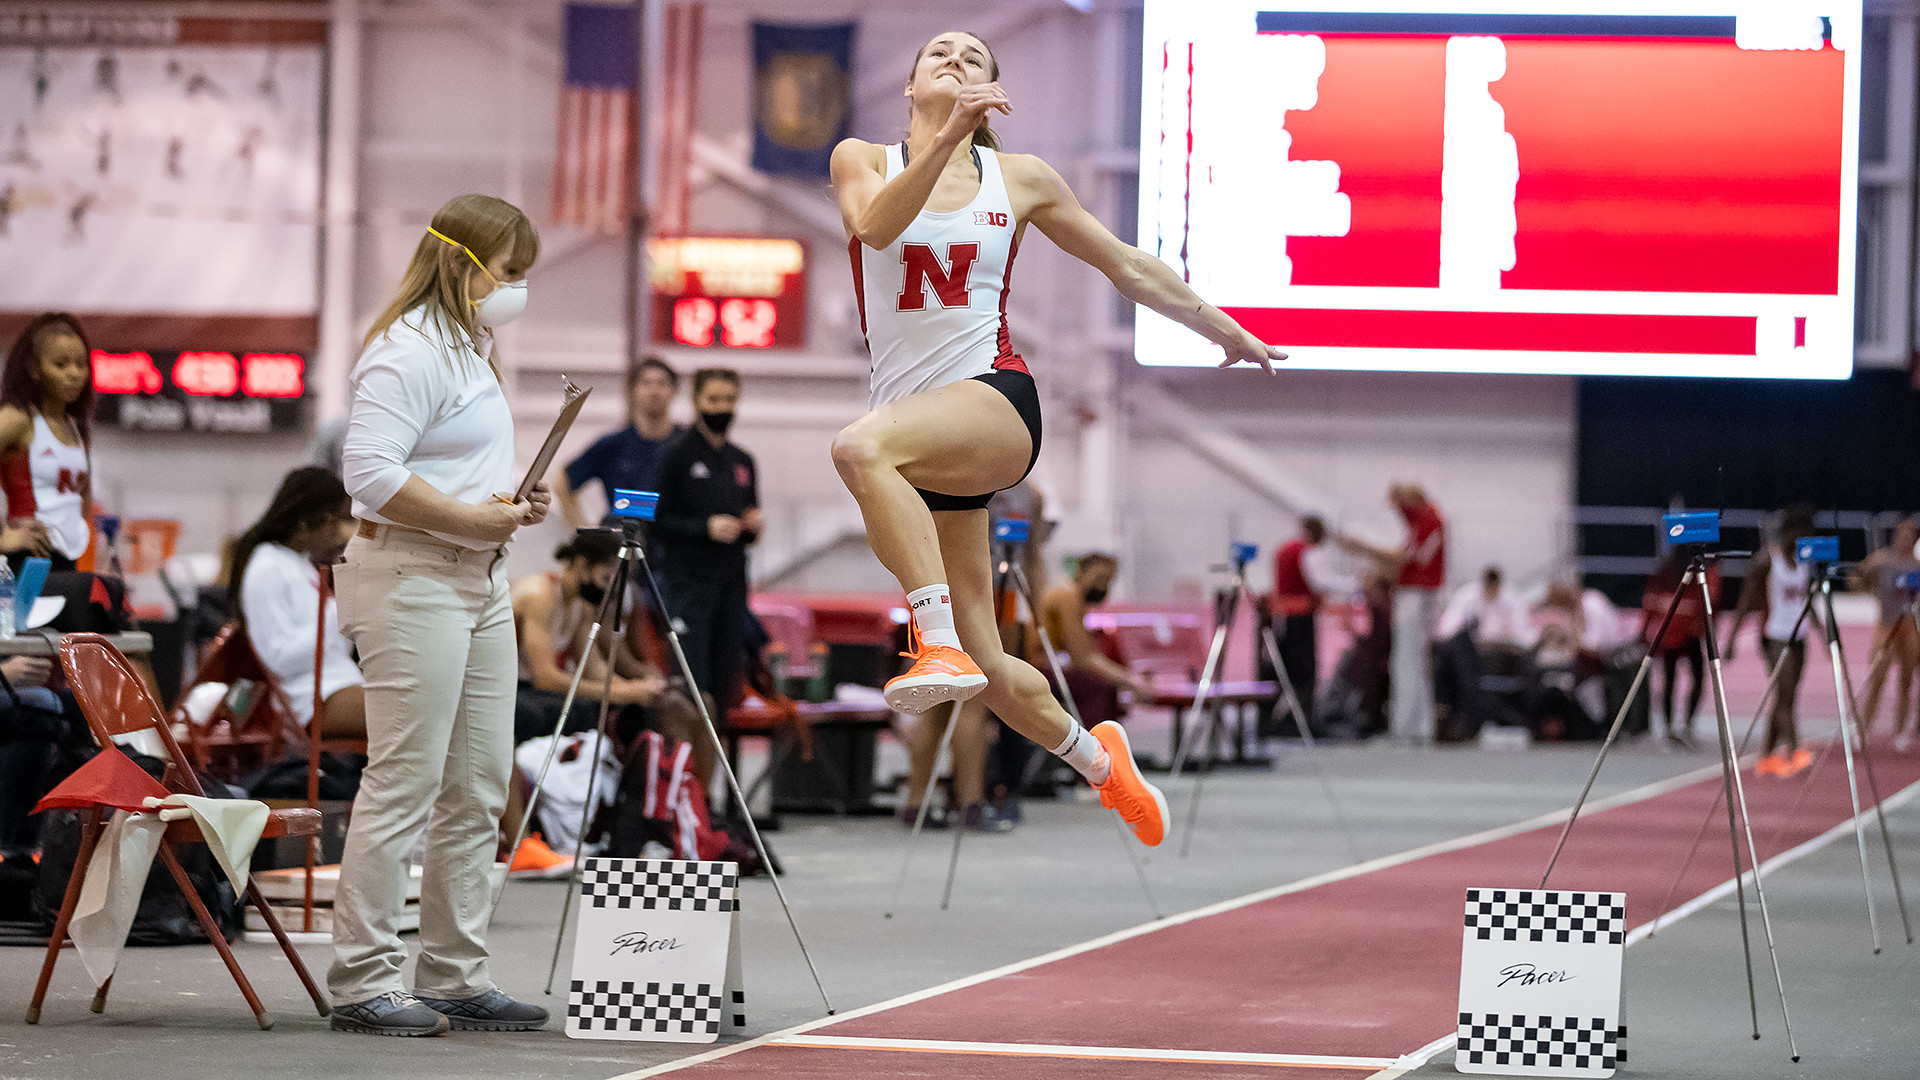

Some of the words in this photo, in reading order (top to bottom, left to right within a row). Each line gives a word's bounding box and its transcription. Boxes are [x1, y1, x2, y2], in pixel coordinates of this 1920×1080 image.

[896, 241, 981, 312] N
[609, 930, 688, 956] Pacer
[1497, 962, 1578, 988] Pacer
